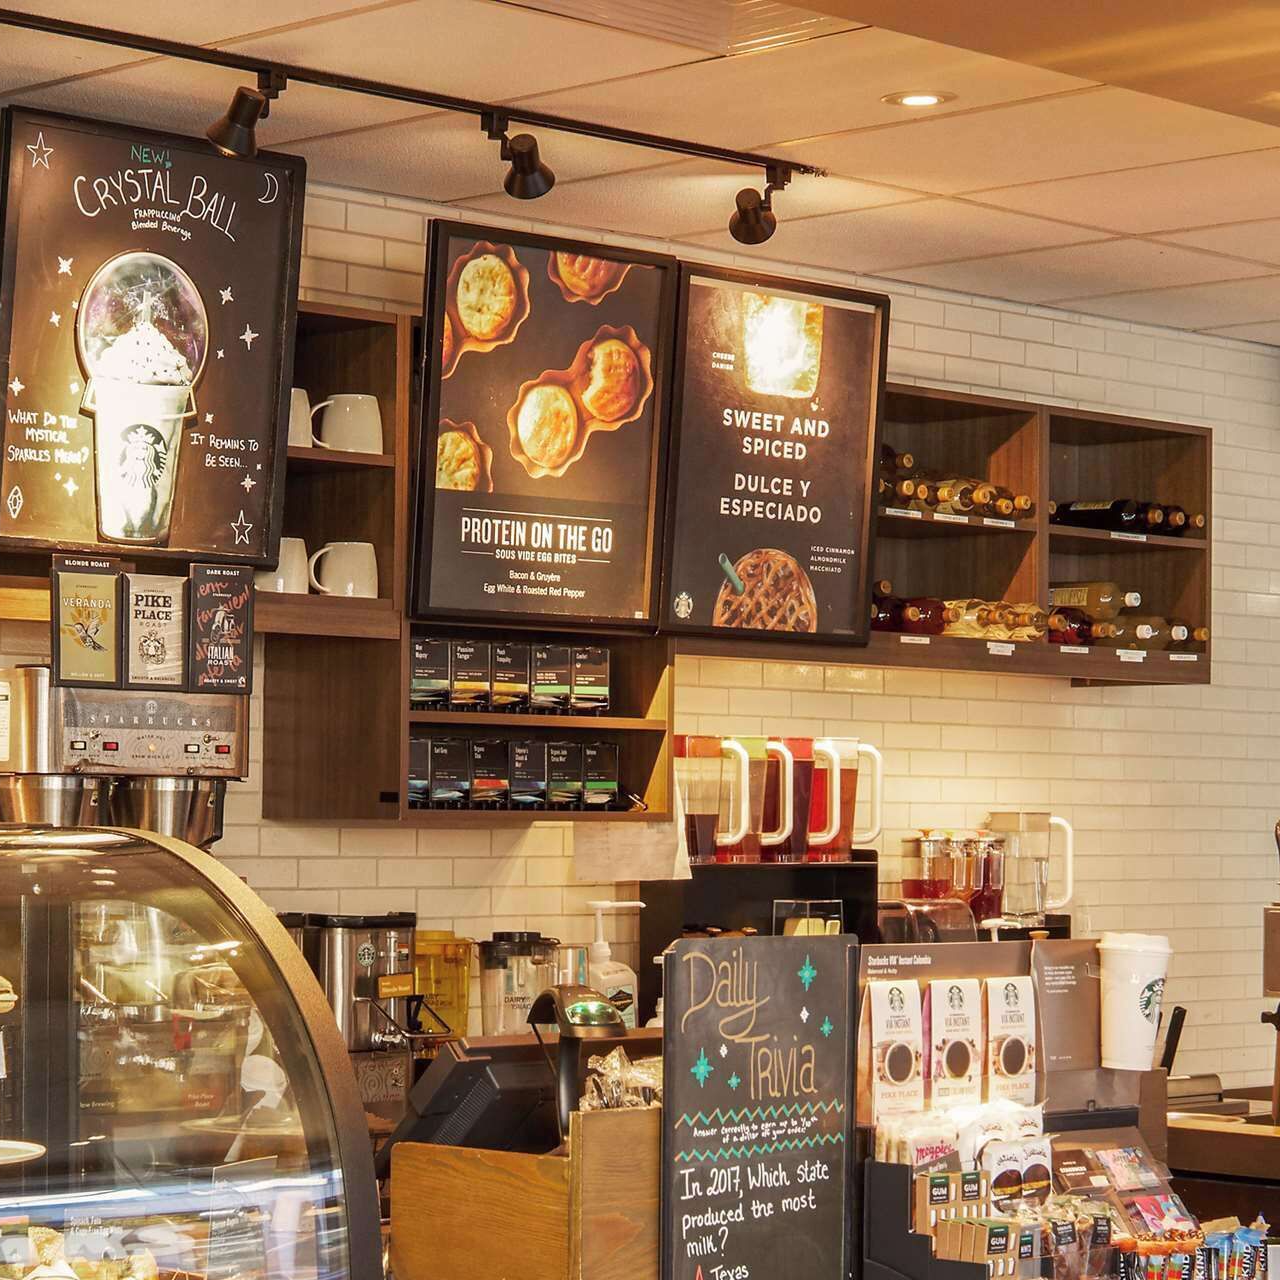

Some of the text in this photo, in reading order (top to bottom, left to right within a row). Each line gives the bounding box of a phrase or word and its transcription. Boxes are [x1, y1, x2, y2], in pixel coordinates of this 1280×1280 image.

[131, 145, 172, 167] NEW!
[74, 168, 237, 242] CRYSTAL BALL
[722, 408, 830, 438] SWEET AND
[190, 432, 259, 451] IT REMAINS TO
[742, 437, 807, 460] SPICED
[205, 454, 218, 467] BE
[734, 473, 811, 497] DULCE Y
[720, 497, 822, 523] ESPECIADO
[461, 517, 612, 553] PROTEIN ON THE GO
[65, 559, 89, 567] BLONDE
[495, 549, 577, 564] SOUS VIDE EGG BITES
[63, 597, 112, 609] VERANDA
[134, 594, 172, 608] PIKE
[134, 610, 172, 621] PLACE
[208, 646, 234, 660] ITALIAN
[208, 658, 233, 666] ROAST
[89, 715, 211, 726] STARBUCKS
[681, 946, 770, 1042] Daily
[680, 1160, 830, 1200] In 2017, Which state
[963, 1182, 978, 1192] GUM
[932, 1186, 948, 1197] GUM
[682, 1191, 816, 1239] produced the most
[687, 1227, 729, 1257] milk?
[990, 1236, 1007, 1247] GUM
[1196, 1248, 1206, 1280] KIND
